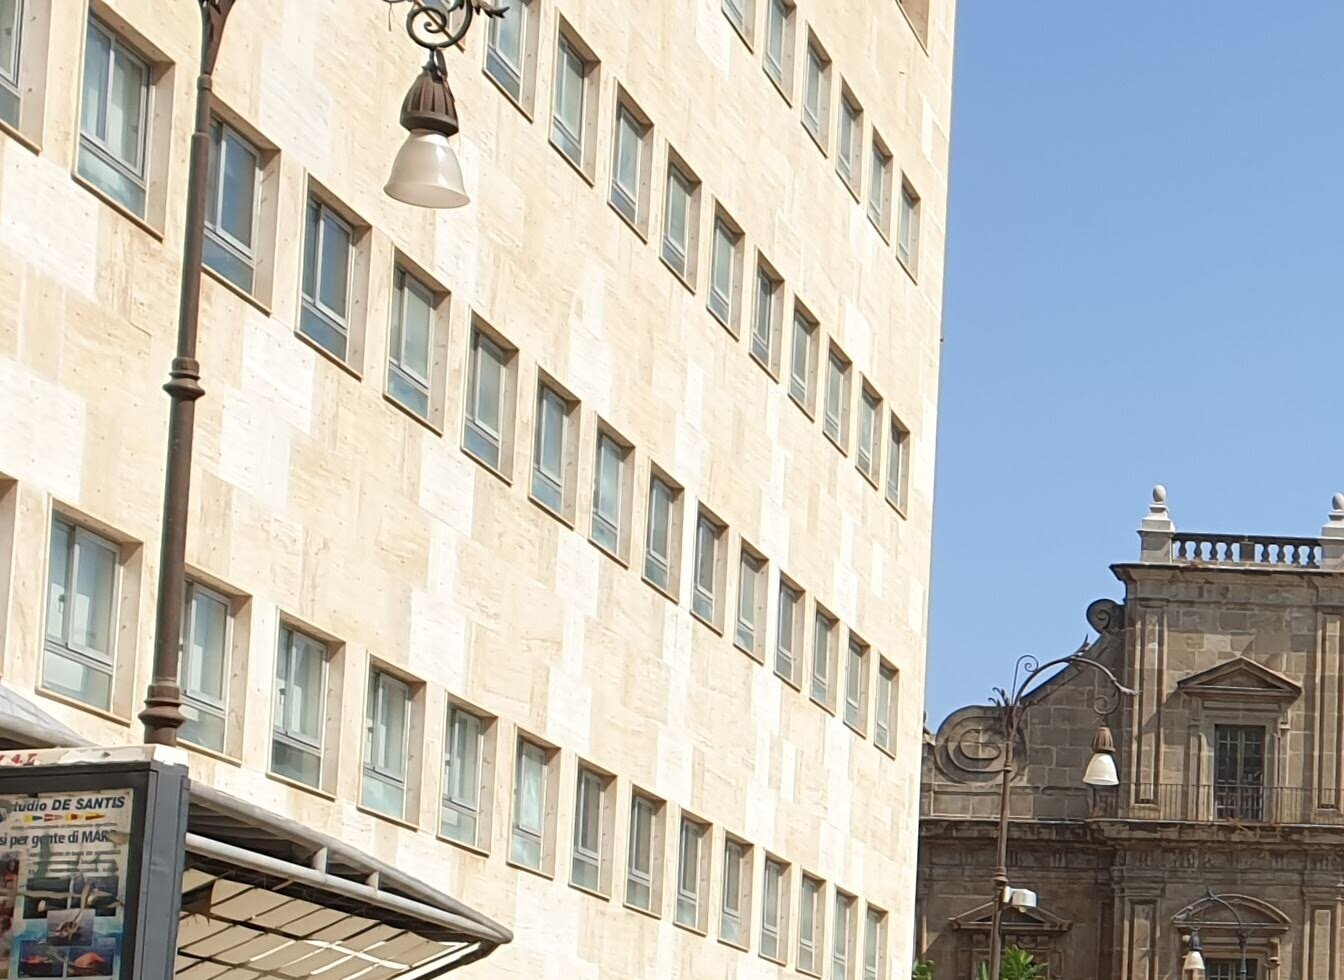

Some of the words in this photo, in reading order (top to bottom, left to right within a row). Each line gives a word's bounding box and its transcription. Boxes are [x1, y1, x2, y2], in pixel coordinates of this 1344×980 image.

[51, 799, 72, 811] DE
[75, 796, 126, 810] SANTIS
[9, 835, 29, 849] per
[32, 833, 65, 848] gnte
[68, 831, 79, 844] di
[82, 830, 116, 844] MAR
